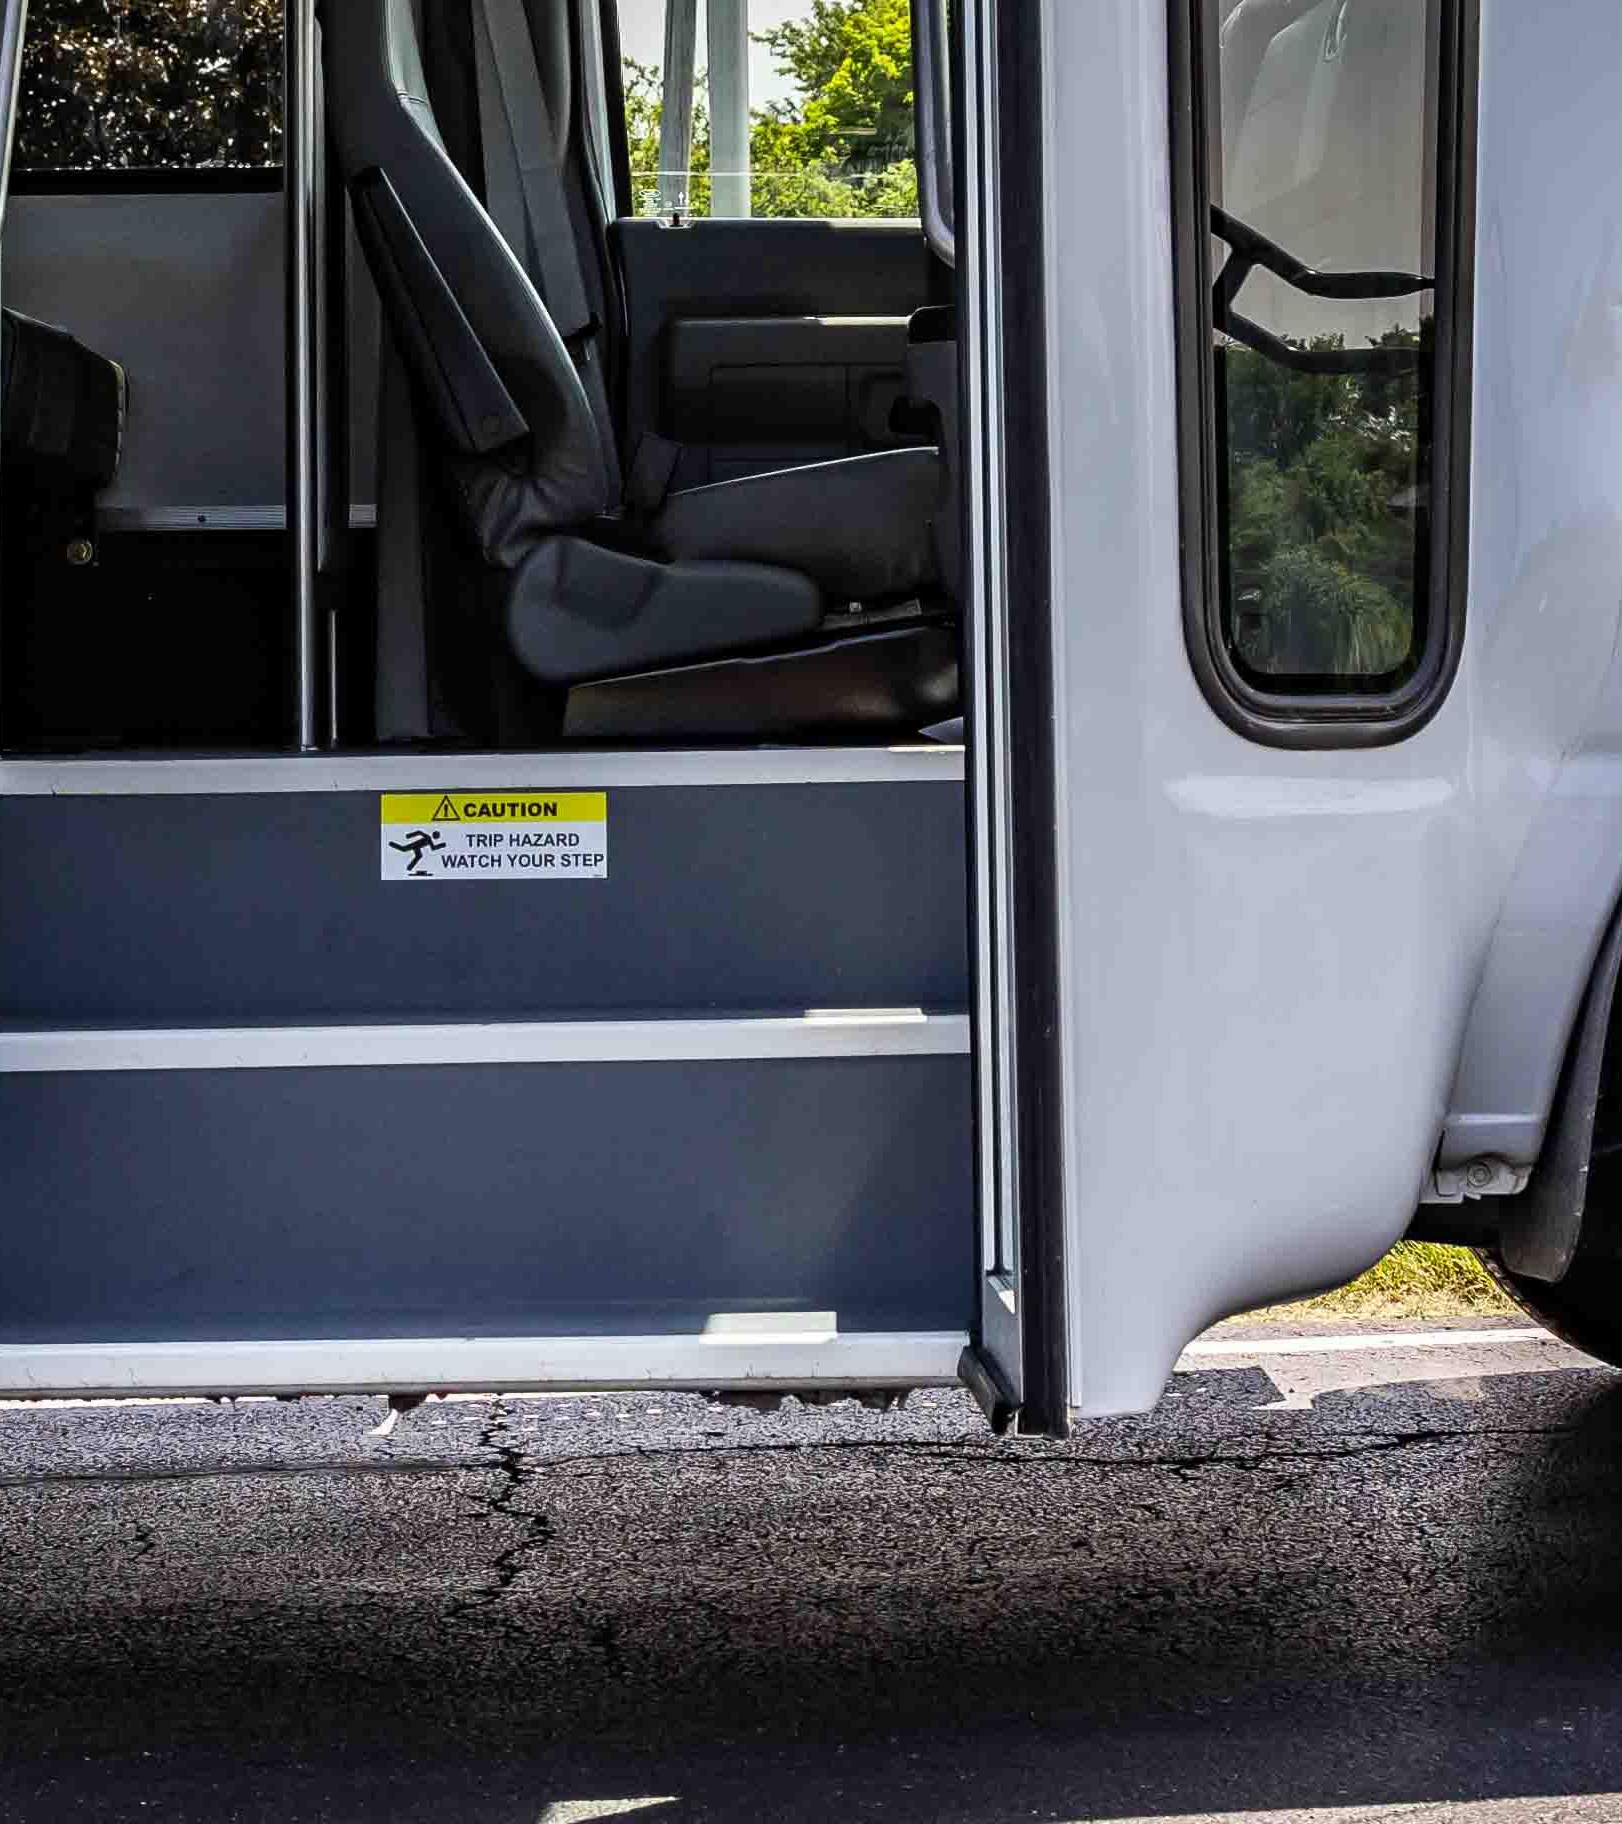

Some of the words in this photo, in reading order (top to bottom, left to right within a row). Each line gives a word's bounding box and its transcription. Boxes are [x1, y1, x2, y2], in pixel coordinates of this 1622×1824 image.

[463, 802, 558, 818] CAUTION
[465, 833, 504, 848] TRIP
[509, 833, 580, 848] HAZARD
[441, 854, 502, 869] WATCH
[506, 854, 555, 869] YOUR
[560, 853, 604, 868] STEP
